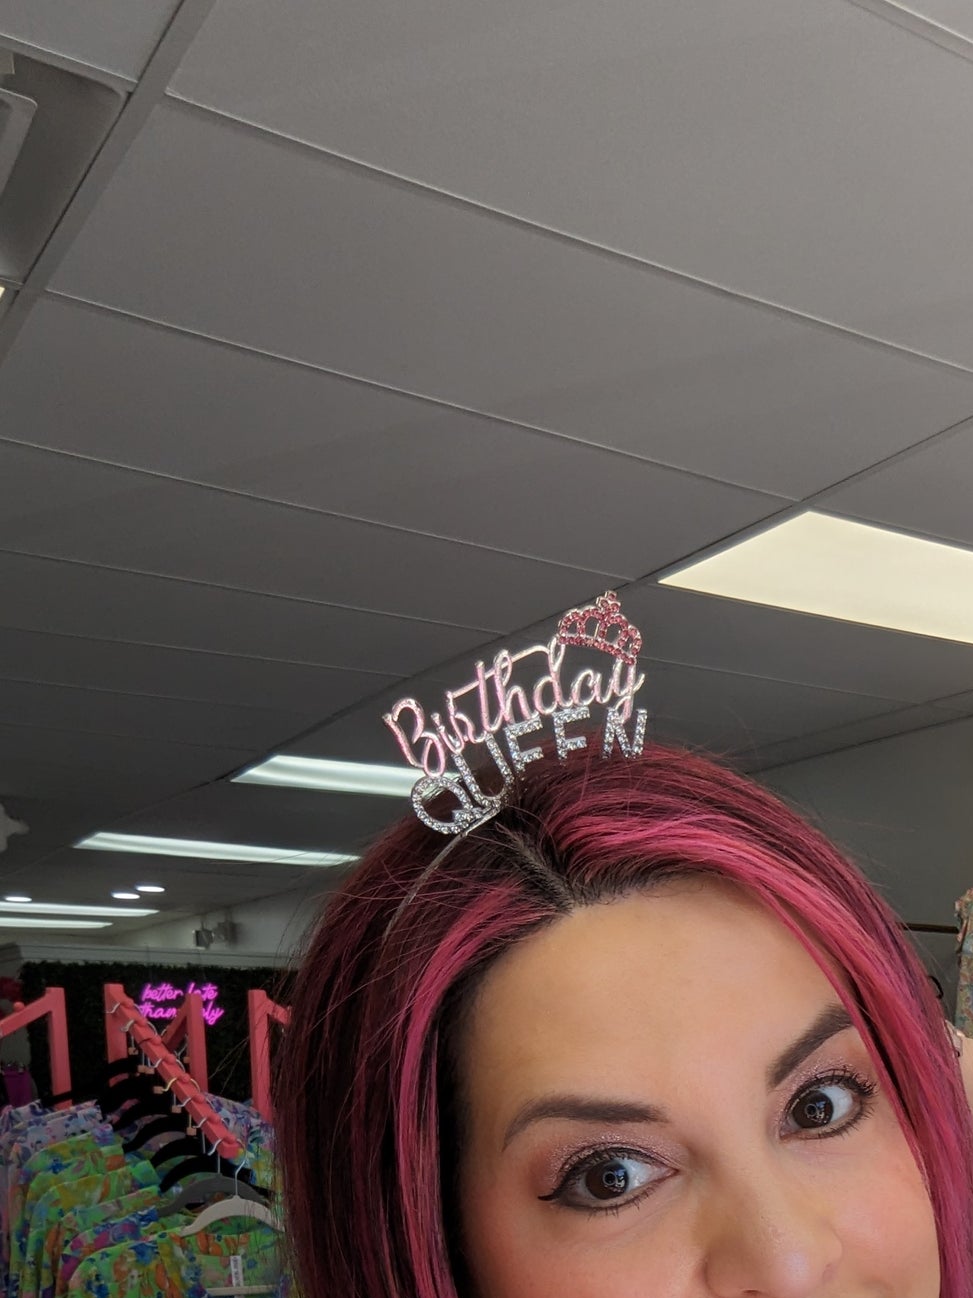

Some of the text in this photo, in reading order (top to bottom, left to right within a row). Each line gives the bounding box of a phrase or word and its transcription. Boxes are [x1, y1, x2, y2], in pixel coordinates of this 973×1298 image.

[382, 635, 646, 778] Birthday
[410, 706, 648, 835] QUEEN
[142, 983, 184, 1002] better
